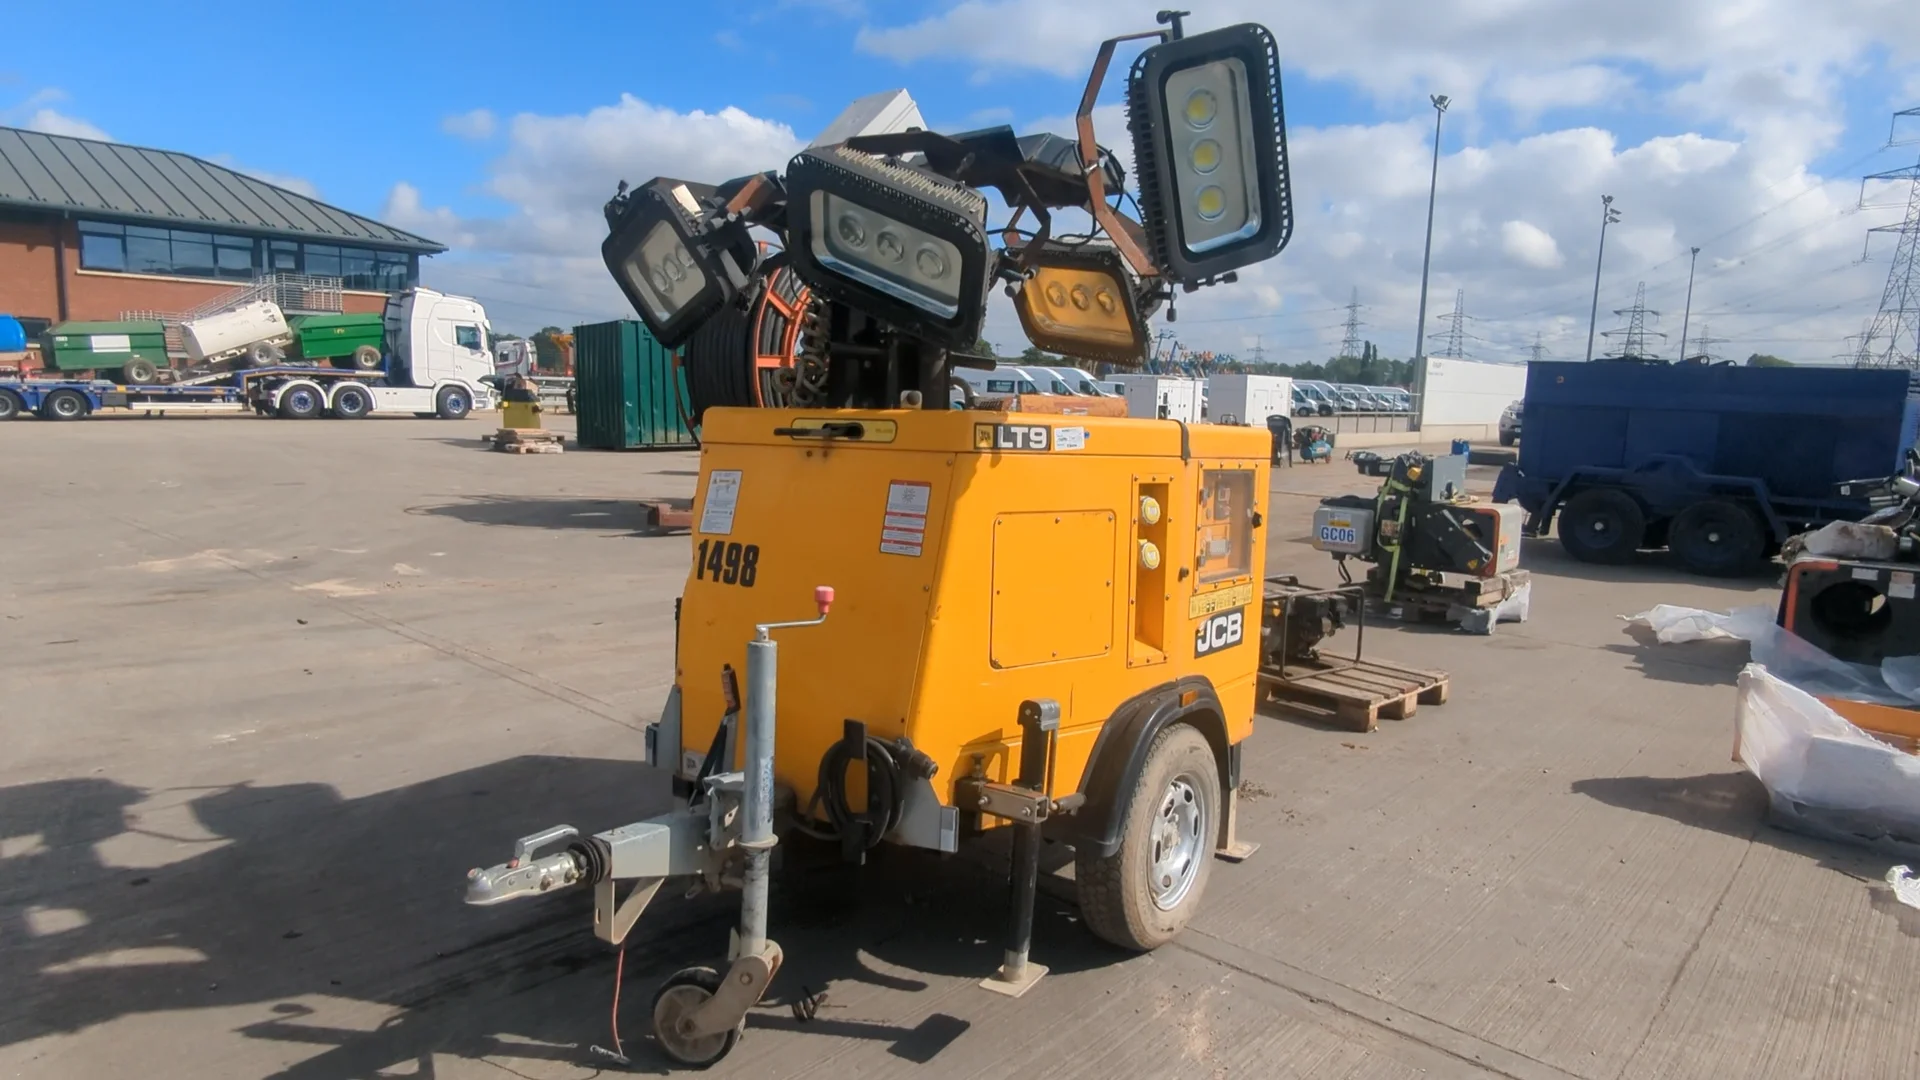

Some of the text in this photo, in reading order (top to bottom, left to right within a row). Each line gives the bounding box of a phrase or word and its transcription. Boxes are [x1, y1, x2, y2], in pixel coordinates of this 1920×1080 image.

[997, 425, 1047, 449] LT9
[1321, 526, 1355, 543] GC06
[696, 539, 760, 588] 1498
[1197, 612, 1243, 653] JCB
